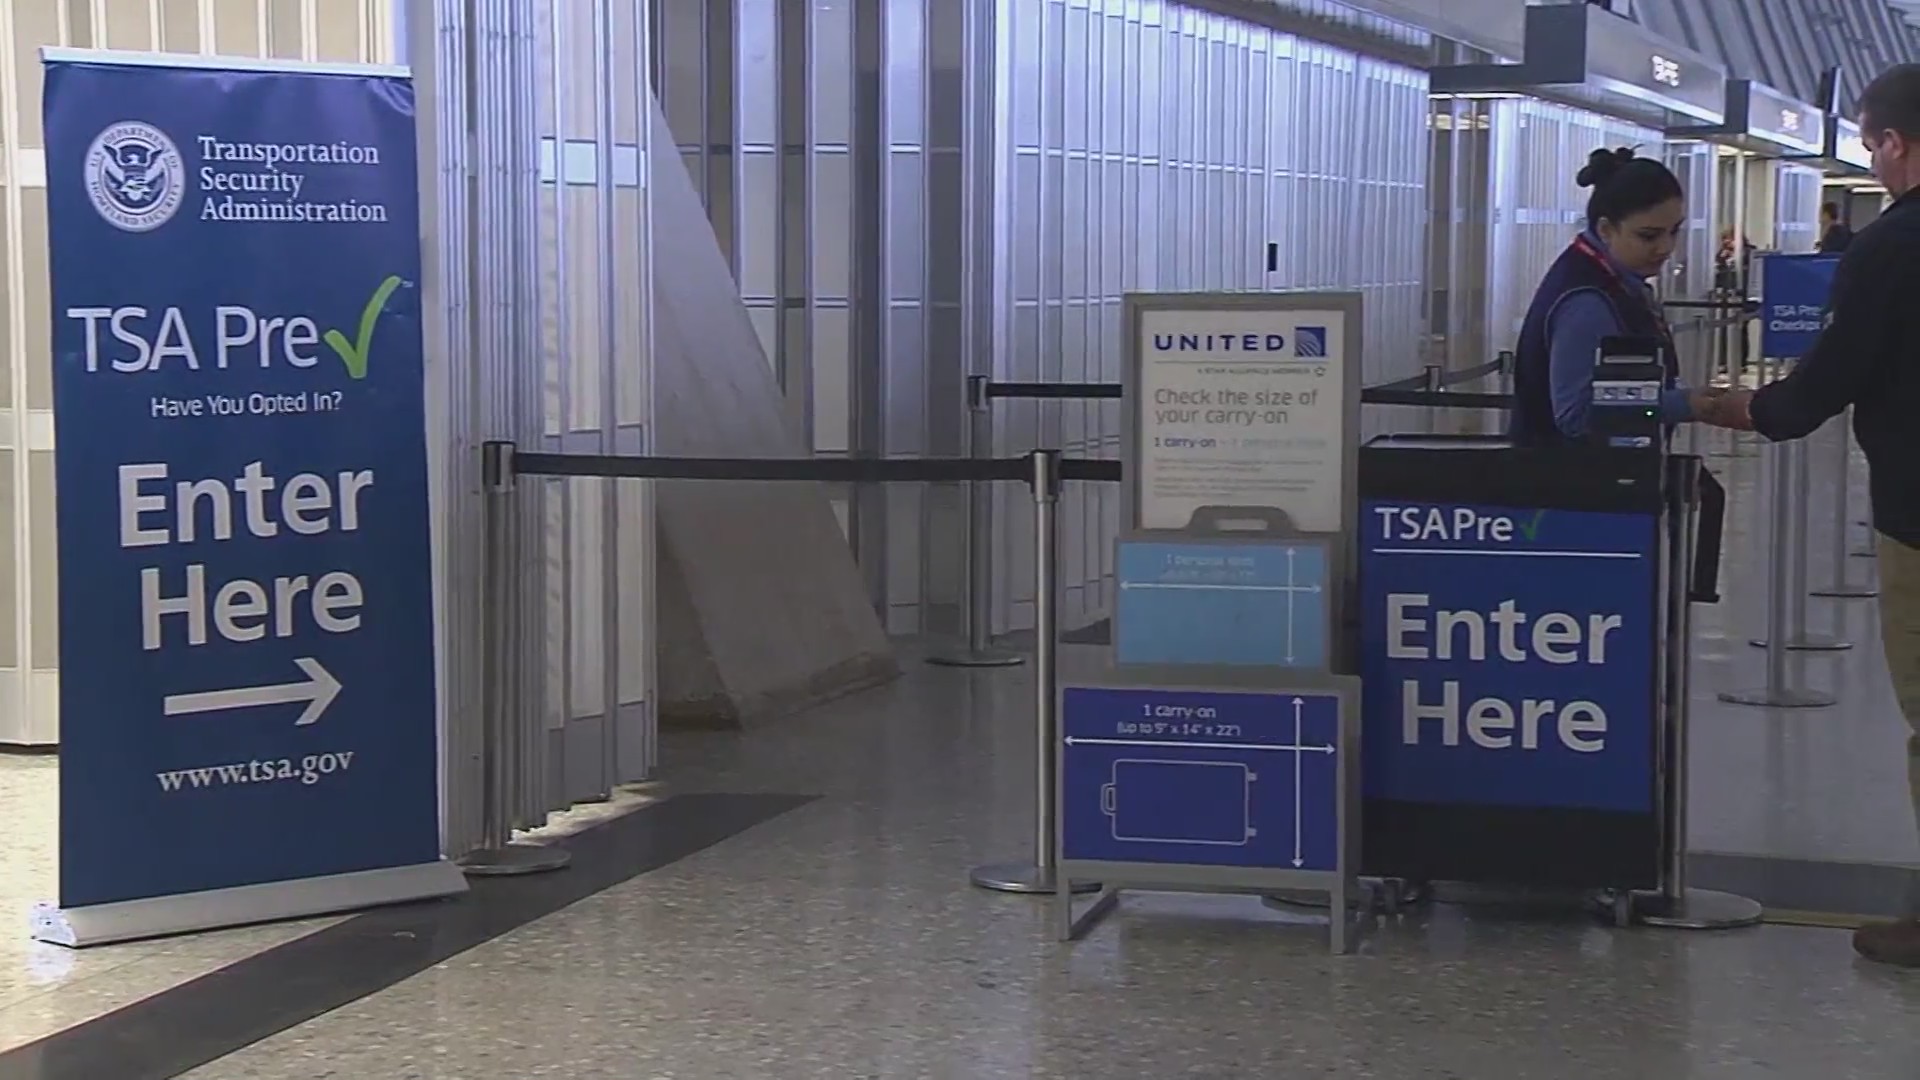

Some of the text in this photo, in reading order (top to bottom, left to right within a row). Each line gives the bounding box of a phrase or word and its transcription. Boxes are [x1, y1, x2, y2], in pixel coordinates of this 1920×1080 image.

[198, 136, 380, 169] Transportation
[201, 168, 304, 198] Security
[200, 197, 388, 222] Administration
[67, 305, 319, 372] TSA Pre
[1154, 334, 1285, 351] UNITED
[151, 391, 343, 417] Have You Opted In?
[1154, 389, 1319, 406] Check the size of
[1154, 409, 1289, 426] your carry-on
[1154, 437, 1161, 447] 1
[1164, 438, 1217, 448] carry-on
[118, 461, 375, 548] Enter
[1374, 507, 1514, 541] TSA Pre
[140, 564, 363, 650] Here
[1387, 593, 1622, 664] Enter
[1143, 704, 1217, 719] 1 carry-on
[1403, 679, 1607, 752] Here
[156, 751, 354, 792] www.tsa.gov
